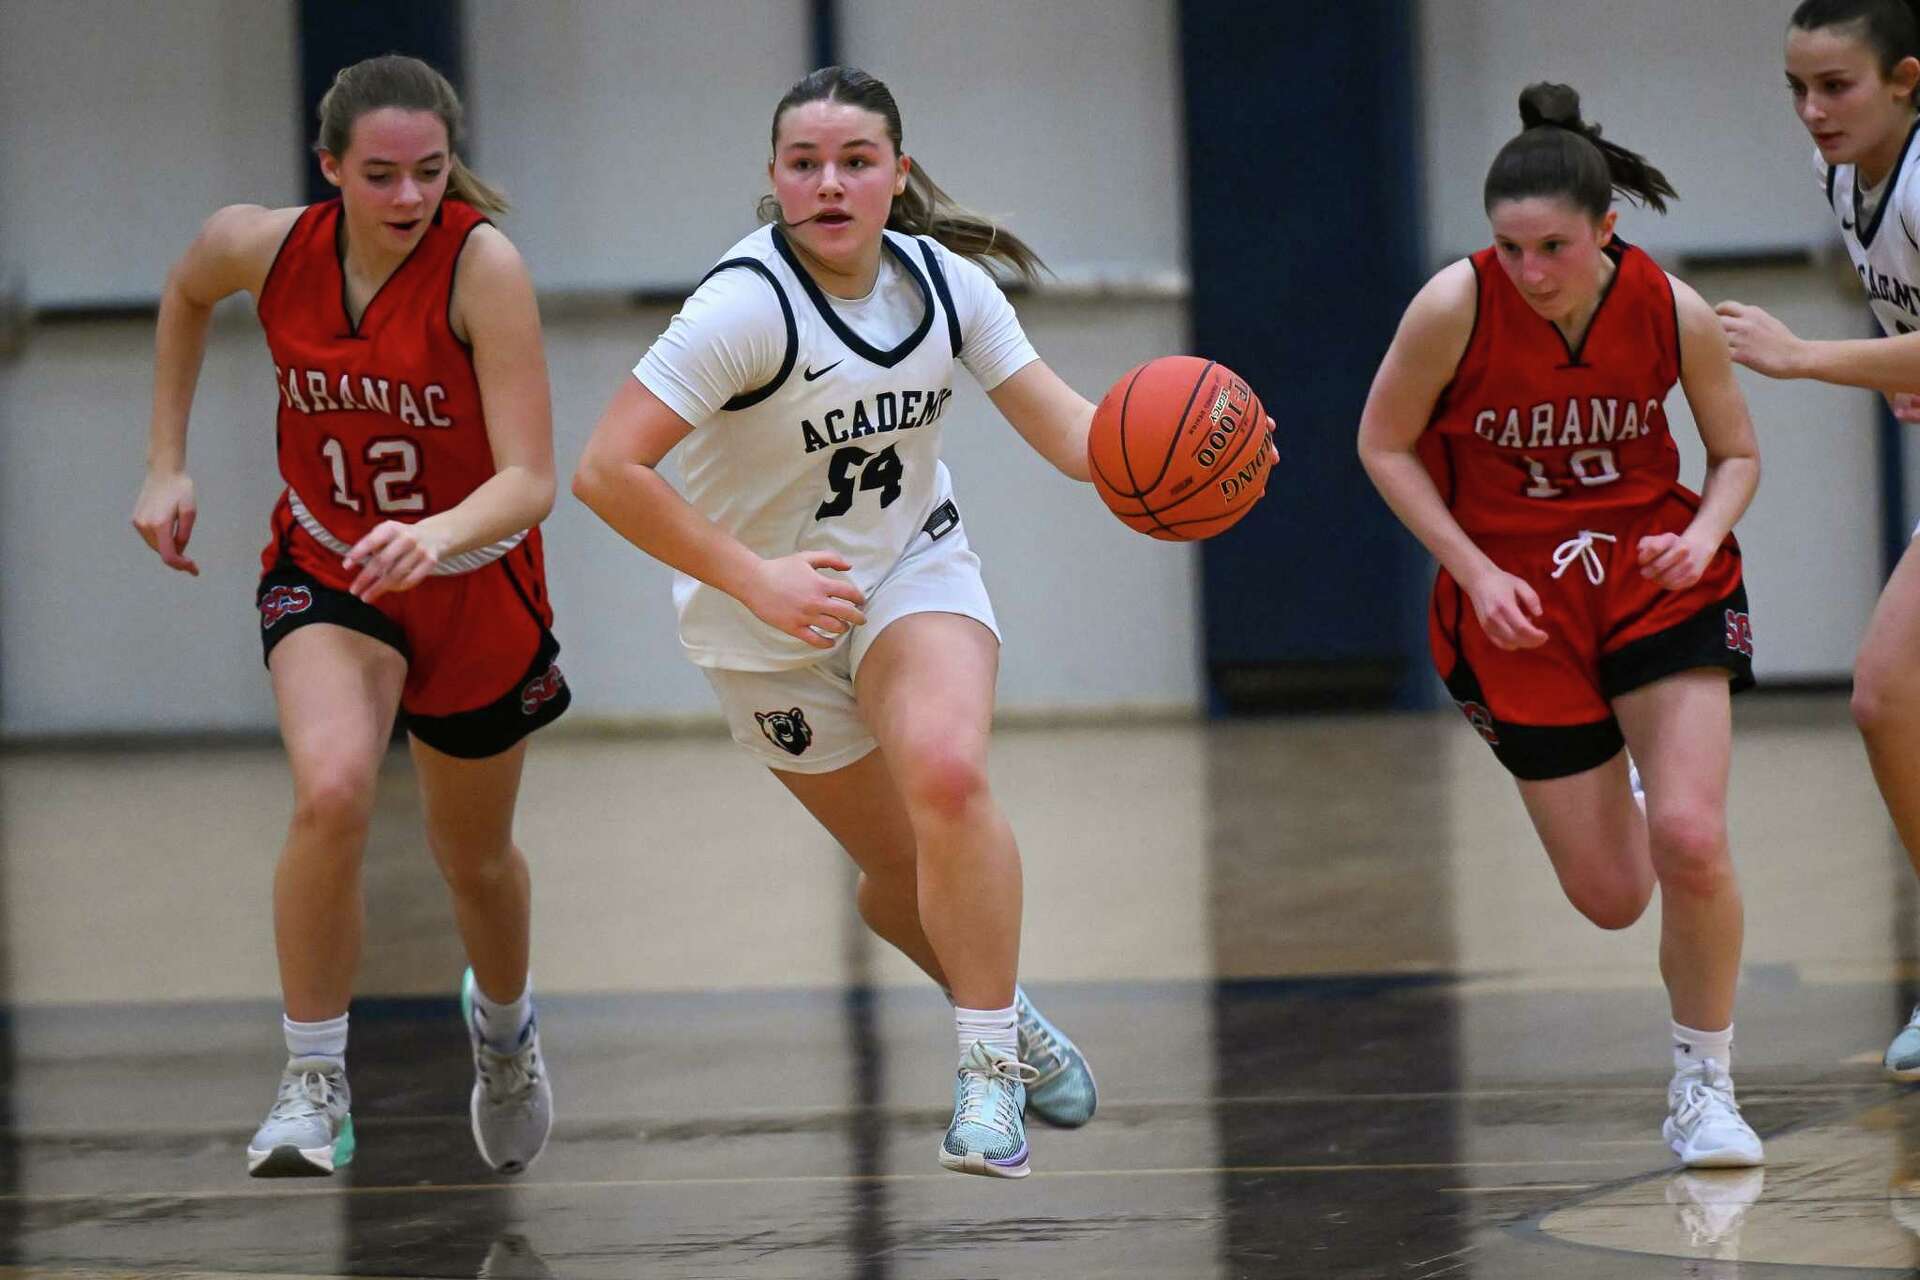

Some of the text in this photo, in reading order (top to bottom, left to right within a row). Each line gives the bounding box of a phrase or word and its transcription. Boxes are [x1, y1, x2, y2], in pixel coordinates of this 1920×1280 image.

[801, 388, 952, 454] ACADEMY
[322, 438, 425, 513] 12
[815, 441, 904, 522] 54
